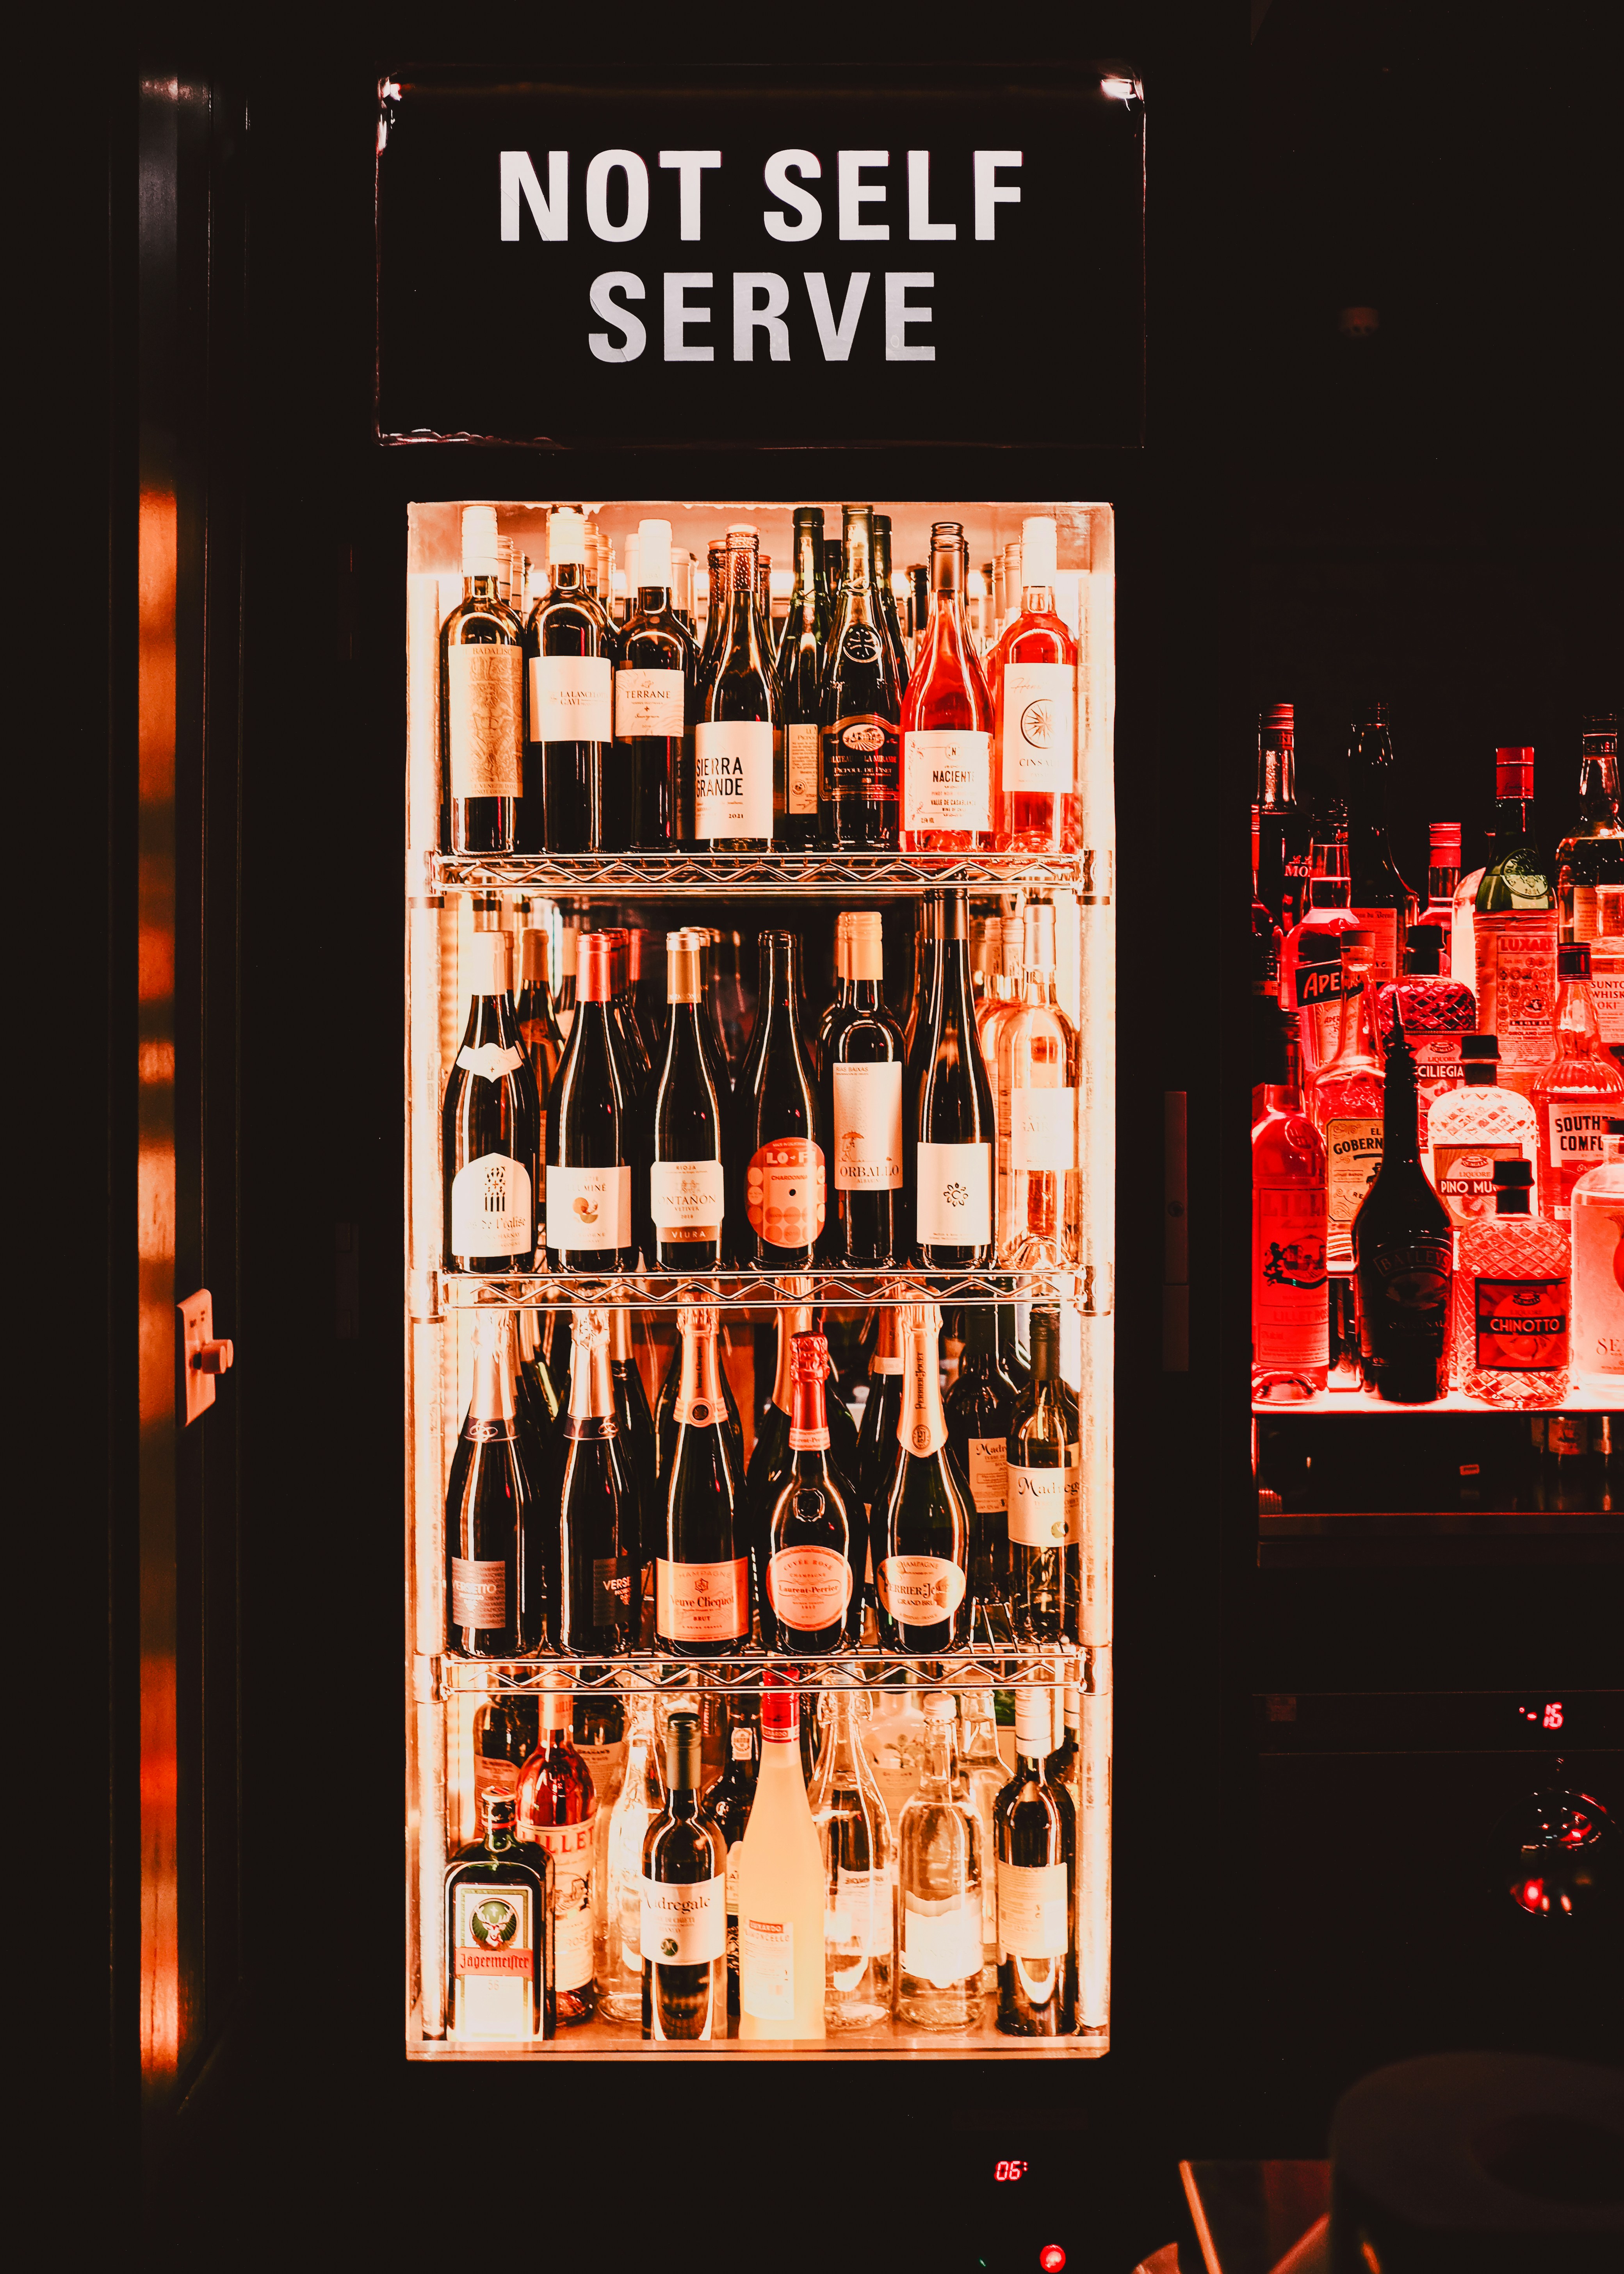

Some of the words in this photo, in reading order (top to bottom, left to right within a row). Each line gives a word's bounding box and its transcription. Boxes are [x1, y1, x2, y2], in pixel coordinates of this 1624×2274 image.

[500, 149, 722, 242] NOT
[763, 149, 1022, 242] SELF
[588, 271, 936, 363] SERVE
[625, 690, 671, 699] TERRANE
[951, 747, 956, 756] N
[696, 757, 743, 777] SIERRA
[696, 778, 744, 797] GRANDE
[1418, 1066, 1464, 1077] CILIEGIA
[1555, 1116, 1615, 1133] SOUTH
[1333, 1137, 1384, 1155] GOBERN
[840, 1165, 899, 1177] ORBALLO
[1441, 1181, 1468, 1193] PINO
[671, 1230, 706, 1239] VIURA
[1381, 1249, 1450, 1270] BAILEYS
[1490, 1319, 1560, 1332] CHINOTTO
[1596, 1338, 1624, 1355] SE
[674, 1570, 732, 1580] HAMPAGNE
[779, 1584, 839, 1593] Laurent-Perrier
[697, 1595, 734, 1608] Clicquot
[644, 1890, 710, 1914] dregale
[751, 1922, 781, 1932] LUXARDO
[488, 1979, 500, 1991] 56
